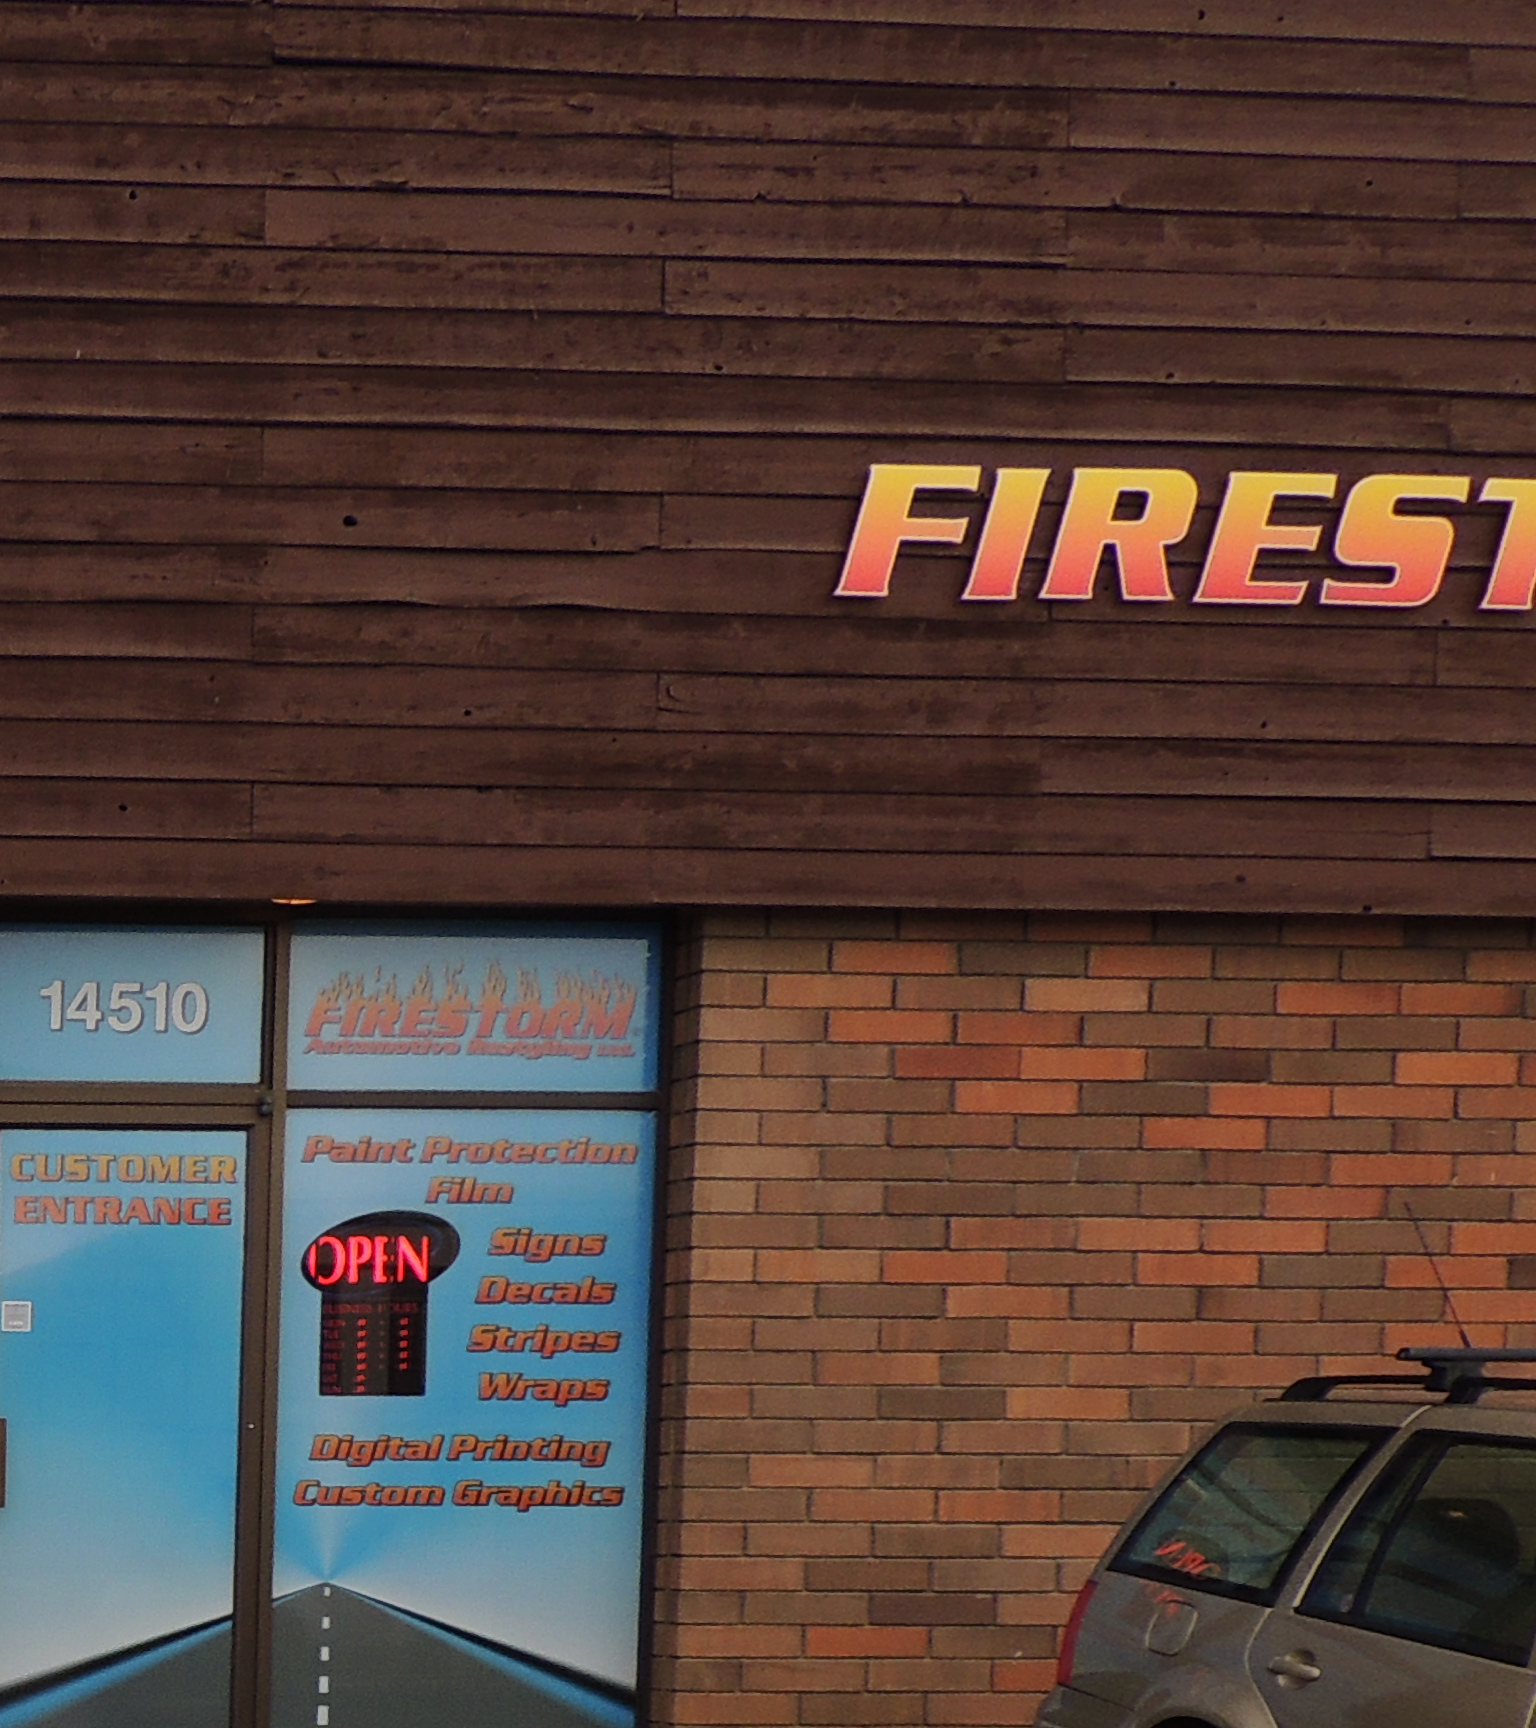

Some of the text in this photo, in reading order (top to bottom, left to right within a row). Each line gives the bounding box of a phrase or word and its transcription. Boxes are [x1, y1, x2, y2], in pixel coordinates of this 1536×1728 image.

[39, 980, 207, 1033] 14510
[304, 980, 637, 1039] FIRESTORM
[304, 1038, 461, 1055] Automotive
[301, 1135, 638, 1164] Paint Protection
[10, 1153, 237, 1183] CUSTOMER
[425, 1176, 514, 1204] Film
[13, 1196, 231, 1225] ENTRANCE
[308, 1234, 430, 1285] OPEN
[488, 1227, 607, 1262] Signs
[474, 1276, 617, 1304] Decals
[466, 1324, 622, 1358] Stripes
[478, 1372, 610, 1406] Wraps
[309, 1434, 611, 1467] Digital Printing
[293, 1479, 625, 1511] Custom Graphics
